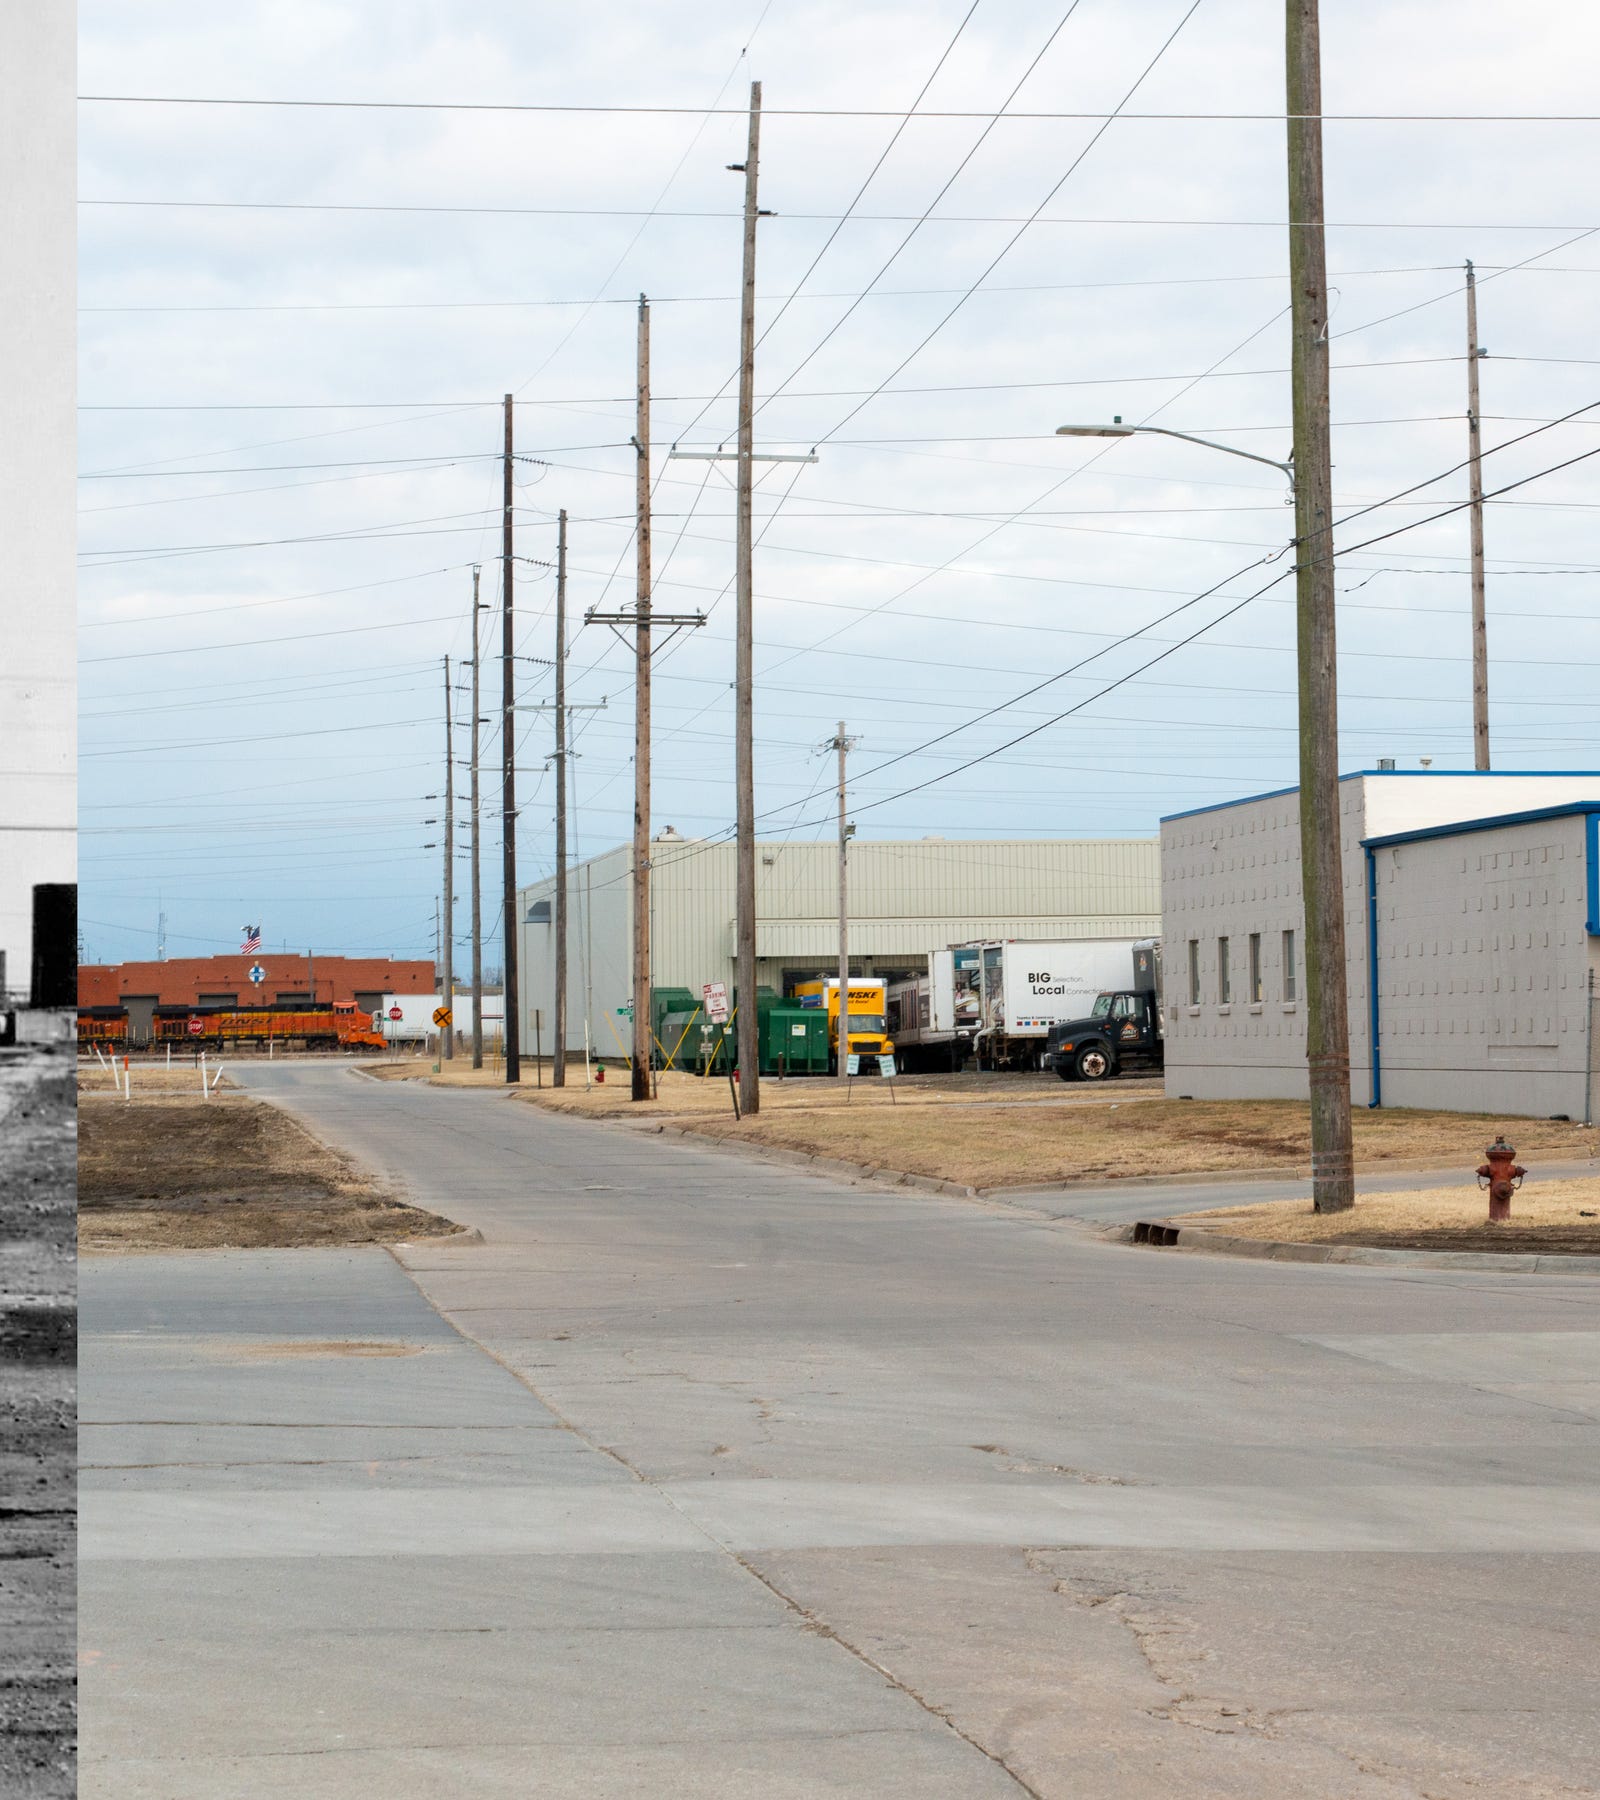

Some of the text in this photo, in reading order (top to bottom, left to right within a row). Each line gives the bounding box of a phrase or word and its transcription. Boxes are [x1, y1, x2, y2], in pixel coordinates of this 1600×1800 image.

[1028, 972, 1051, 983] BIG
[1033, 985, 1065, 995] Local
[833, 991, 878, 999] PNSKE
[189, 1022, 203, 1030] STOP
